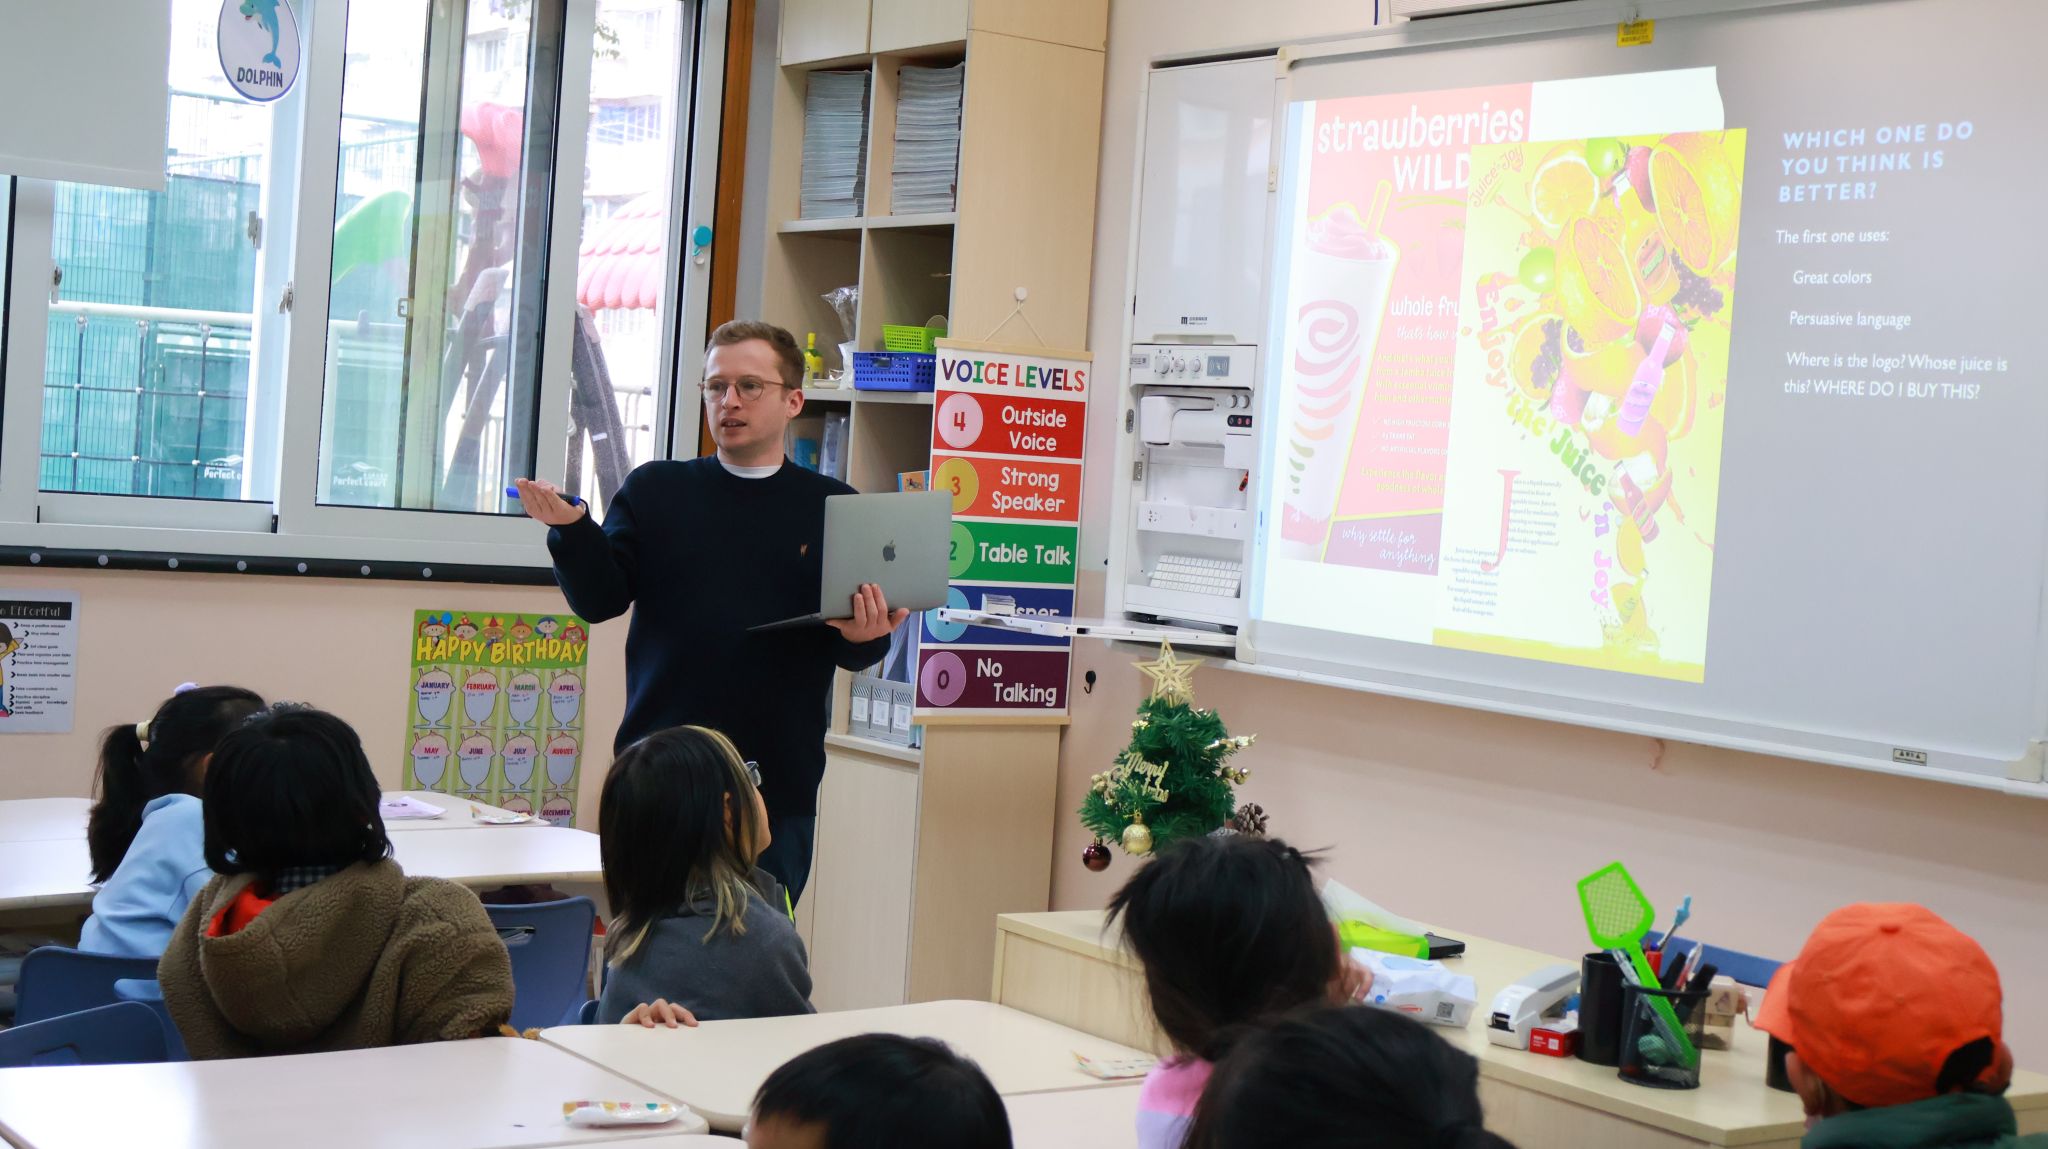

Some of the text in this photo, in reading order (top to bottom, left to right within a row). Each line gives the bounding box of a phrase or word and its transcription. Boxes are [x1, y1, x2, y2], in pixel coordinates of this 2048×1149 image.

[237, 66, 283, 88] DOLPHIN
[1318, 102, 1524, 154] strawberries
[1784, 120, 1974, 150] WHICH ONE DO
[1393, 152, 1470, 192] WILD
[1782, 150, 1944, 176] YOU THINK IS
[1778, 181, 1878, 203] BETTER?
[1776, 229, 1890, 244] The first one uses:
[1793, 270, 1872, 284] Great colors
[1391, 296, 1433, 316] whole
[1476, 273, 1508, 389] Enjoy
[1790, 311, 1911, 330] Persuasive language
[1786, 352, 2008, 374] Where is the logo? Whose juice is
[942, 358, 1085, 392] VOICE LEVELS
[1784, 379, 1980, 400] this? WHERE DO I BUY THIS?
[954, 412, 966, 432] 4
[1002, 405, 1067, 428] Outside
[1010, 430, 1056, 451] Voice
[1506, 396, 1606, 497] the Juice
[952, 476, 960, 496] 3
[1001, 466, 1060, 492] Strong
[992, 491, 1065, 513] Speaker
[1480, 469, 1521, 572] J
[1342, 525, 1416, 546] why settle for
[950, 541, 957, 560] 2
[979, 542, 1072, 566] Table Talk
[1380, 548, 1436, 570] anything
[1590, 550, 1612, 608] Joy
[416, 636, 586, 664] HAPPY BIRTHDAY
[976, 658, 1002, 678] No
[421, 682, 450, 690] JANUARY
[558, 684, 574, 692] APRIL
[938, 670, 950, 690] 0
[994, 682, 1056, 706] Talking
